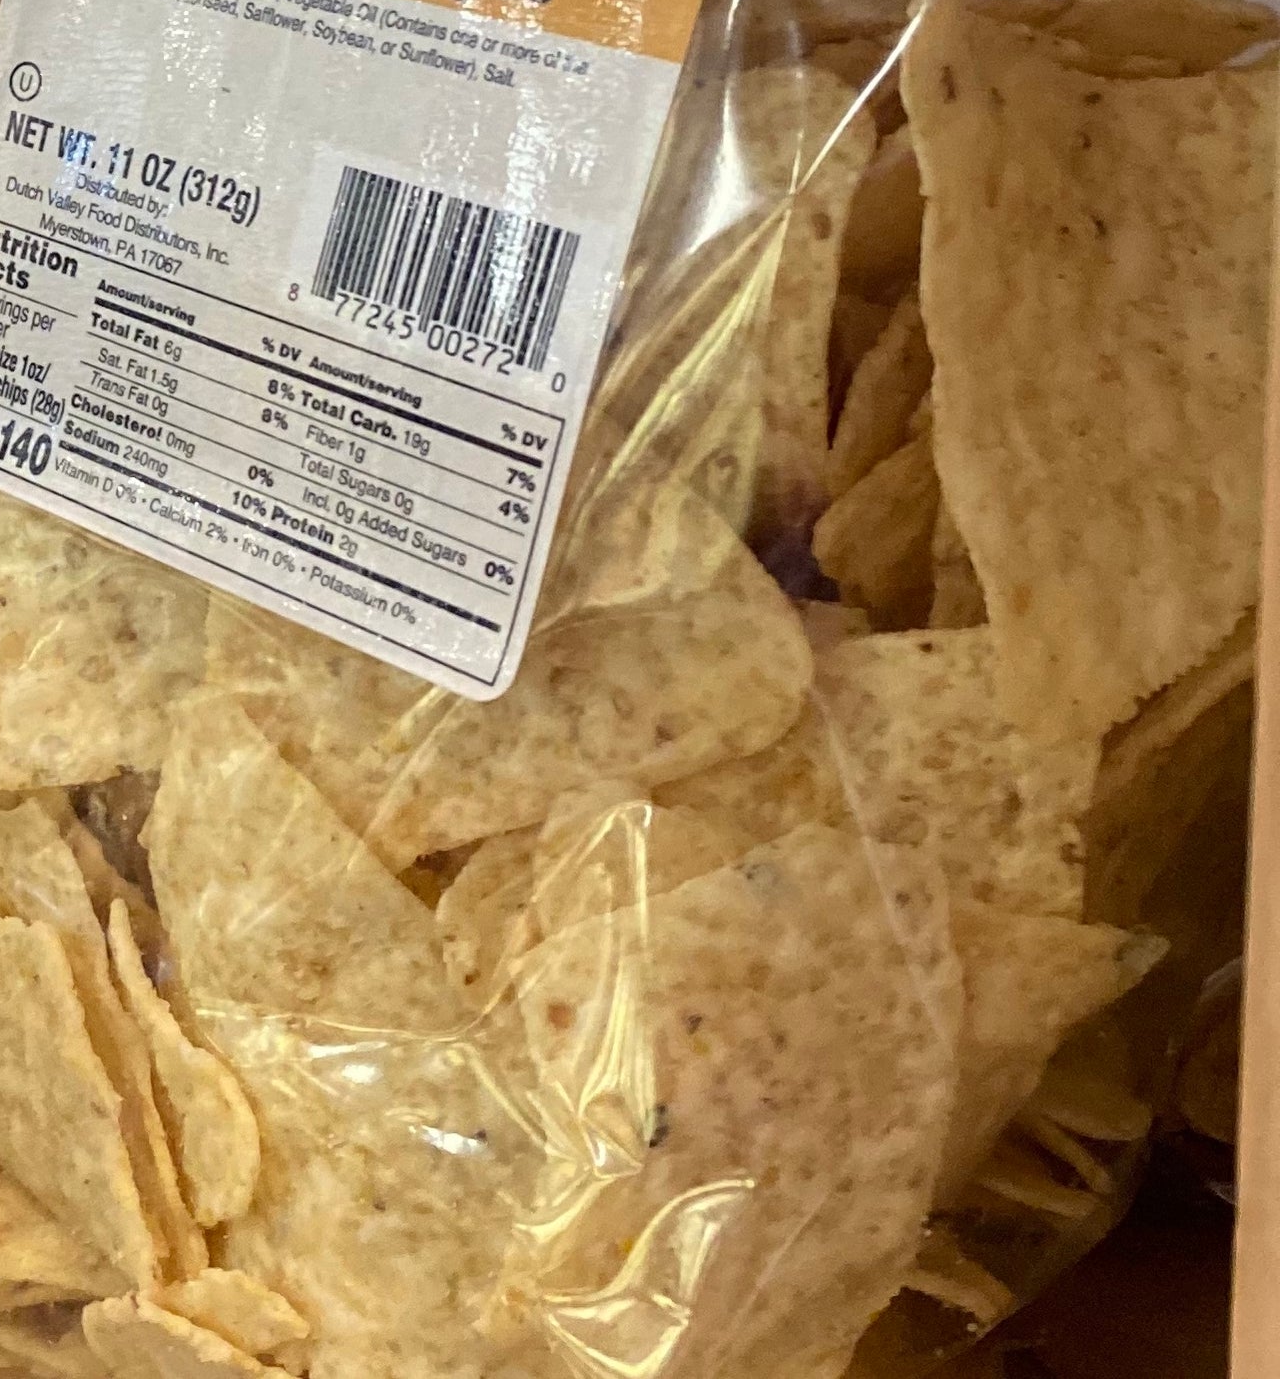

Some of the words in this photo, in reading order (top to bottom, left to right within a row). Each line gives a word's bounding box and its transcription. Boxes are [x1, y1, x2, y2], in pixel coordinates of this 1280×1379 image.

[244, 2, 308, 36] Safflower,
[312, 19, 377, 54] Soybean,
[380, 41, 397, 56] or
[357, 3, 379, 22] Oil
[379, 9, 448, 41] (Contains
[450, 30, 478, 49] one
[481, 37, 500, 53] or
[500, 42, 540, 64] more
[5, 110, 55, 153] NET
[58, 125, 97, 169] WT.
[109, 142, 135, 180] 11
[141, 153, 177, 193] OZ
[179, 165, 261, 227] (312g)
[75, 172, 145, 211] Distributed
[6, 176, 44, 202] Dutch
[47, 188, 86, 219] Valley
[88, 203, 121, 229] Food
[124, 212, 201, 259] Distributors,
[206, 242, 230, 266] Inc.
[39, 213, 112, 253] Myerstown,
[115, 239, 136, 261] PA
[141, 248, 182, 277] 17067
[31, 310, 57, 333] per
[91, 312, 130, 339] Total
[134, 329, 159, 351] Fat
[164, 340, 183, 362] 6g
[97, 279, 197, 326] Amount/serving
[262, 336, 276, 354] %
[278, 343, 302, 364] DV
[287, 282, 301, 302] 8
[333, 292, 417, 340] 77245
[427, 323, 516, 375] 00272
[551, 371, 567, 393] 0
[20, 355, 52, 385] 1oz/
[90, 371, 126, 398] Trans
[128, 388, 150, 408] Fat
[151, 396, 170, 418] 0g
[97, 347, 122, 371] Sat.
[126, 358, 149, 380] Fat
[150, 367, 179, 394] 1.5g
[31, 387, 66, 425] (28g)
[309, 356, 423, 409] Amount/serving
[500, 423, 517, 442] %
[522, 432, 548, 452] DV
[63, 419, 121, 456] Sodium
[122, 445, 169, 478] 240mg
[232, 490, 267, 517] 10%
[71, 393, 163, 442] Cholesterol
[165, 431, 196, 458] 0mg
[247, 465, 275, 488] 0%
[301, 390, 345, 421] Total
[349, 410, 398, 440] Carb.
[402, 430, 431, 456] 19g
[505, 467, 536, 494] 7%
[299, 452, 334, 479] Total
[337, 468, 391, 504] Sugars
[393, 490, 415, 516] 0g
[306, 424, 344, 452] Fiber
[347, 441, 367, 464] 1g
[498, 500, 531, 525] 4%
[55, 457, 100, 488] Vitamin
[101, 474, 114, 493] D
[115, 483, 138, 505] 0%
[148, 498, 202, 532] Calcium
[204, 522, 229, 544] 2%
[241, 536, 269, 564] Iron
[272, 550, 297, 572] 0%
[309, 566, 388, 611] Potassium
[391, 602, 418, 625] 0%
[271, 505, 335, 545] Protein
[338, 535, 359, 559] 2g
[302, 487, 332, 513] Incl.
[334, 501, 355, 525] 0g
[358, 510, 409, 542] Added
[411, 530, 468, 567] Sugars
[484, 561, 514, 585] 0%
